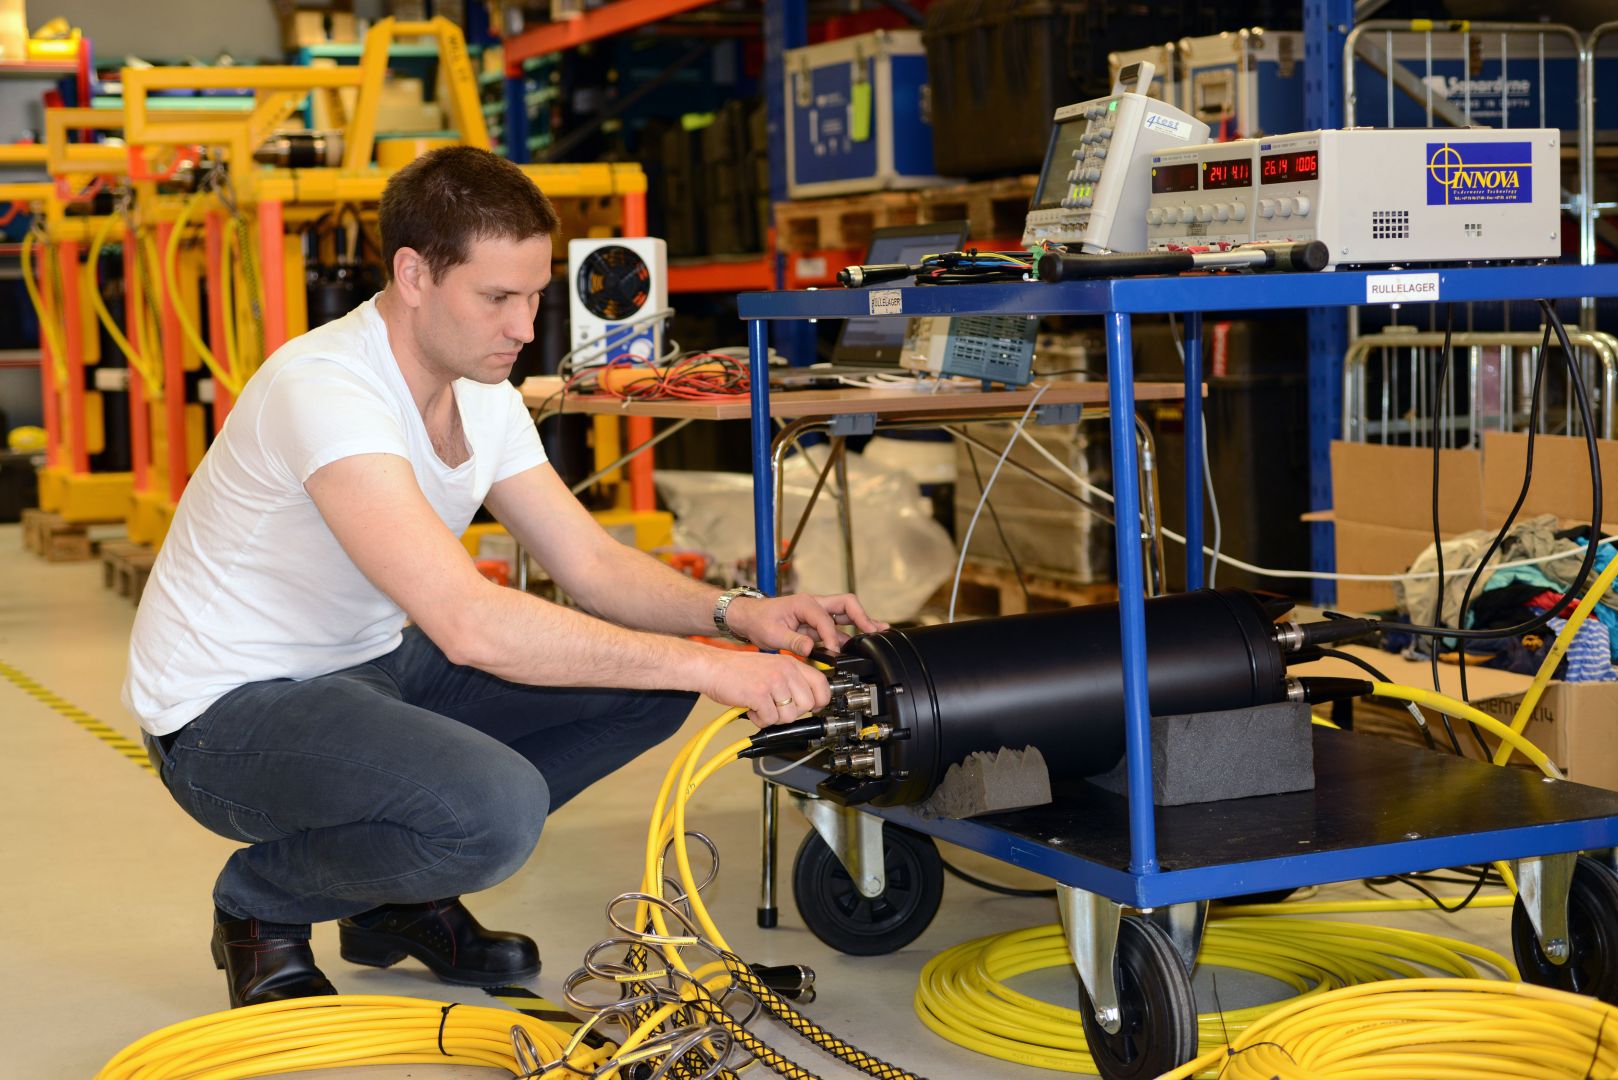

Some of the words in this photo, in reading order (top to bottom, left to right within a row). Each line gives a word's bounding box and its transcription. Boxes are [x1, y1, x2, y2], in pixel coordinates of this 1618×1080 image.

[1264, 159, 1288, 176] 26.14
[1295, 155, 1317, 173] 10.06
[1451, 170, 1520, 189] INNOVA
[1372, 283, 1435, 293] RULLELAGER
